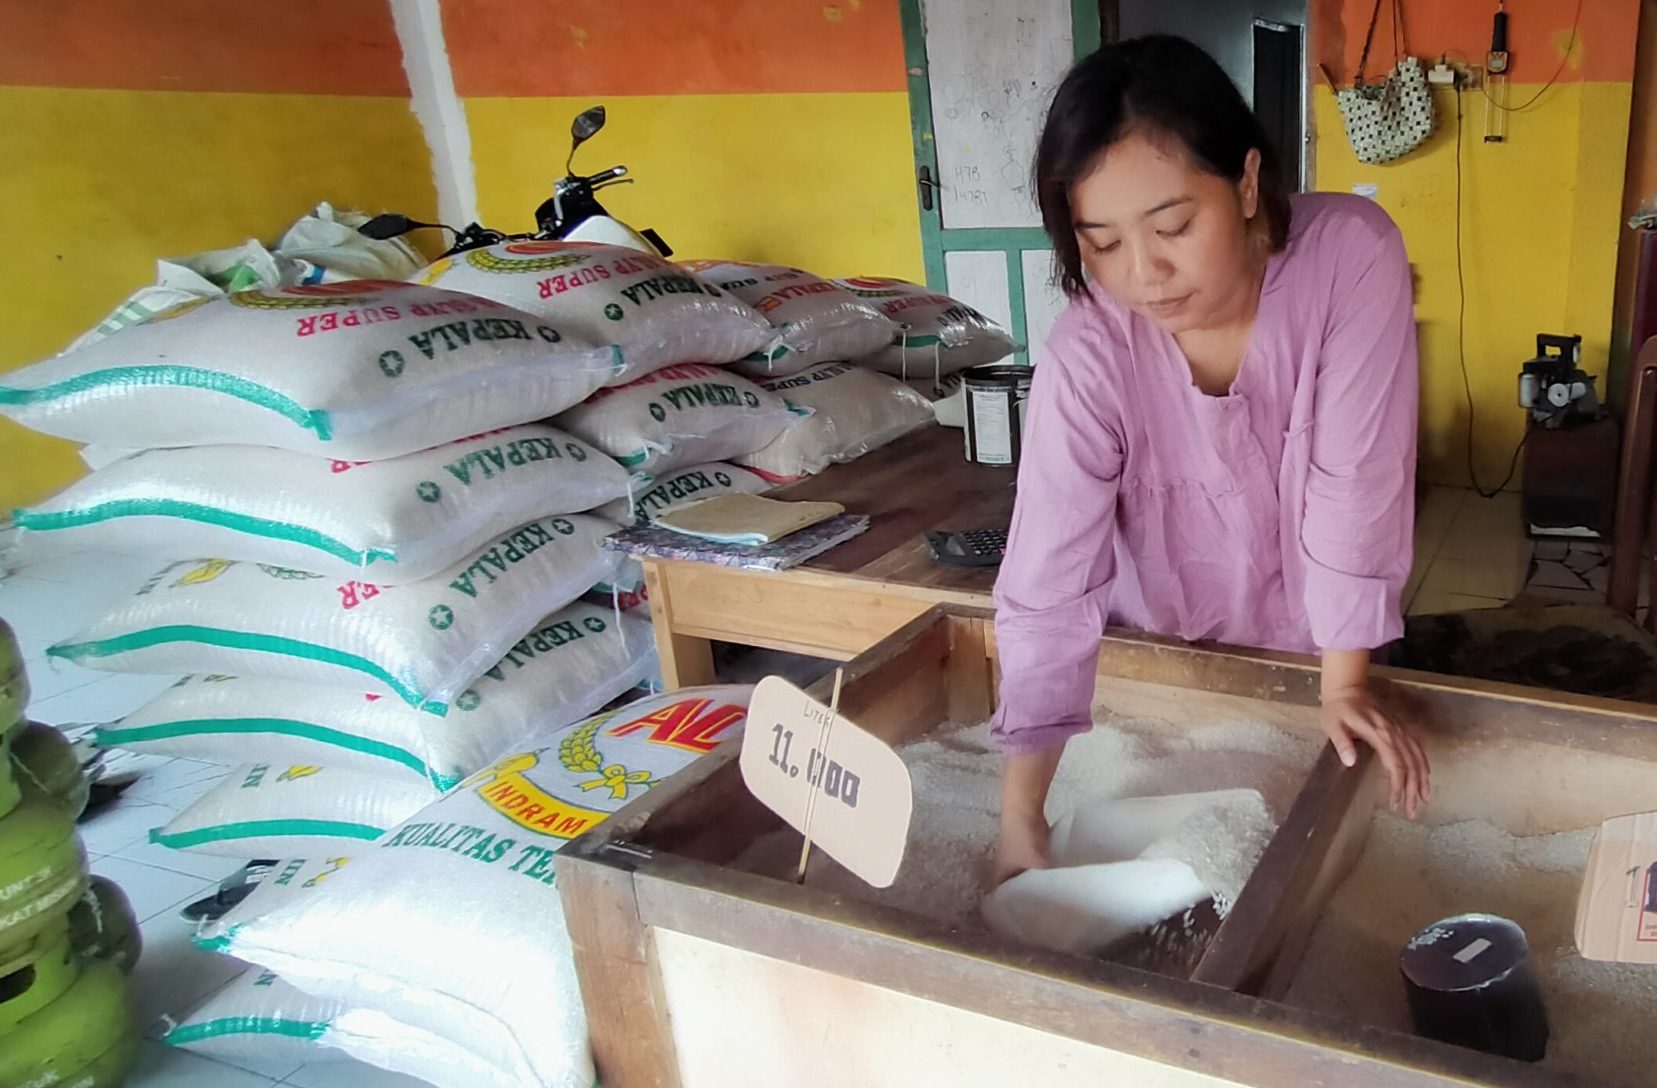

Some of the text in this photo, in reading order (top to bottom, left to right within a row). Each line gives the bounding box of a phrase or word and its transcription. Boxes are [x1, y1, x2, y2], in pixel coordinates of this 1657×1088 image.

[536, 264, 611, 300] SUPER
[297, 306, 402, 337] SUPER
[408, 318, 534, 361] KEPALA
[443, 437, 564, 486] KEPALA
[449, 523, 555, 599] KEPALA
[484, 620, 585, 682] KEPALA
[381, 823, 517, 864] KUALITAS
